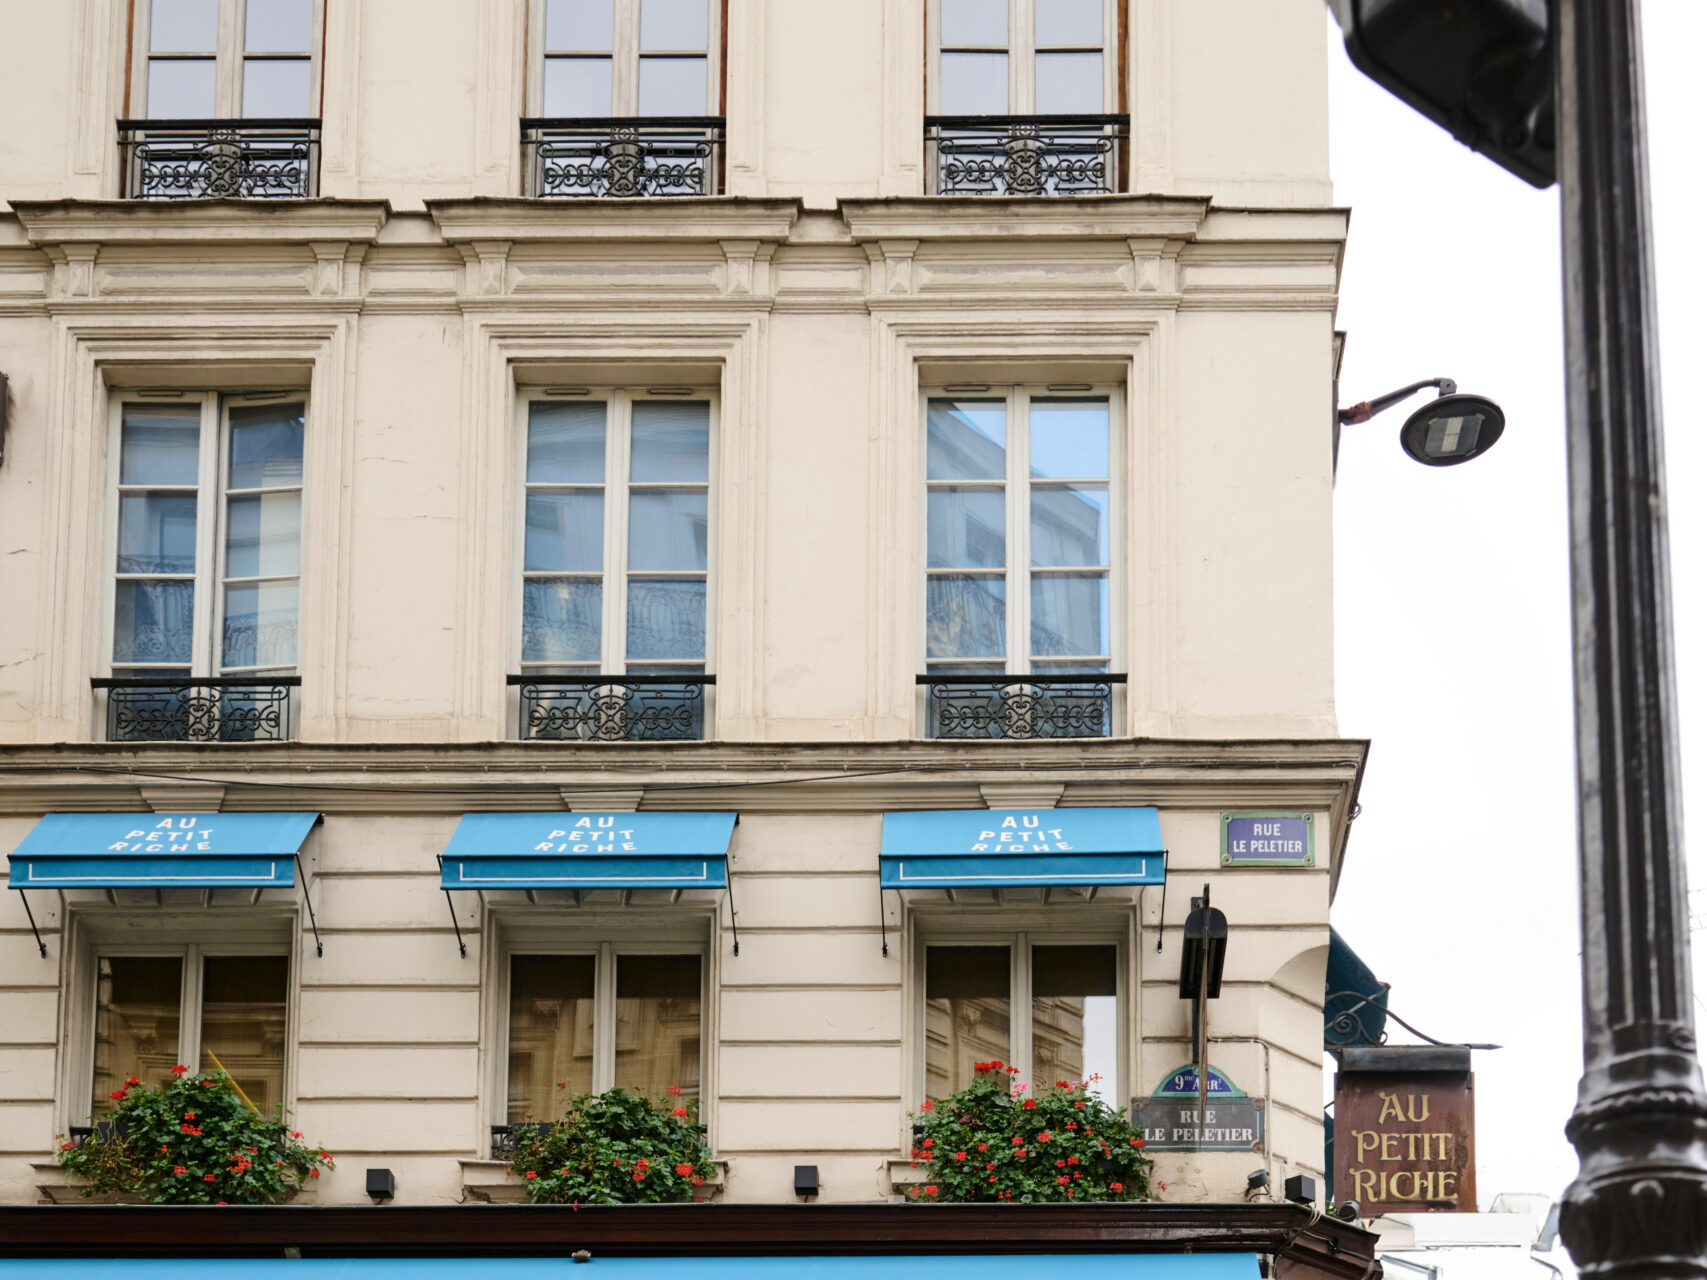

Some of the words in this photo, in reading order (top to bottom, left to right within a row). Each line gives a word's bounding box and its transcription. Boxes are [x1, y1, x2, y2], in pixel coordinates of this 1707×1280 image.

[155, 818, 197, 829] AU
[574, 816, 615, 828] AU
[1001, 815, 1040, 828] AU
[124, 829, 214, 842] PETIT
[547, 830, 634, 842] PETIT
[978, 828, 1063, 842] PETIT
[1253, 824, 1281, 836] RUE
[107, 841, 212, 852] RICHE
[534, 841, 638, 852] RICHE
[970, 842, 1074, 852] RICHE
[1233, 840, 1246, 852] LE
[1250, 840, 1303, 852] PELETIER
[1378, 1091, 1431, 1125] AU
[1180, 1110, 1216, 1124] RUE
[1144, 1128, 1166, 1141] LE
[1172, 1128, 1253, 1141] PELETIER
[1351, 1129, 1453, 1164] PETIT
[1348, 1168, 1459, 1204] RICHE
